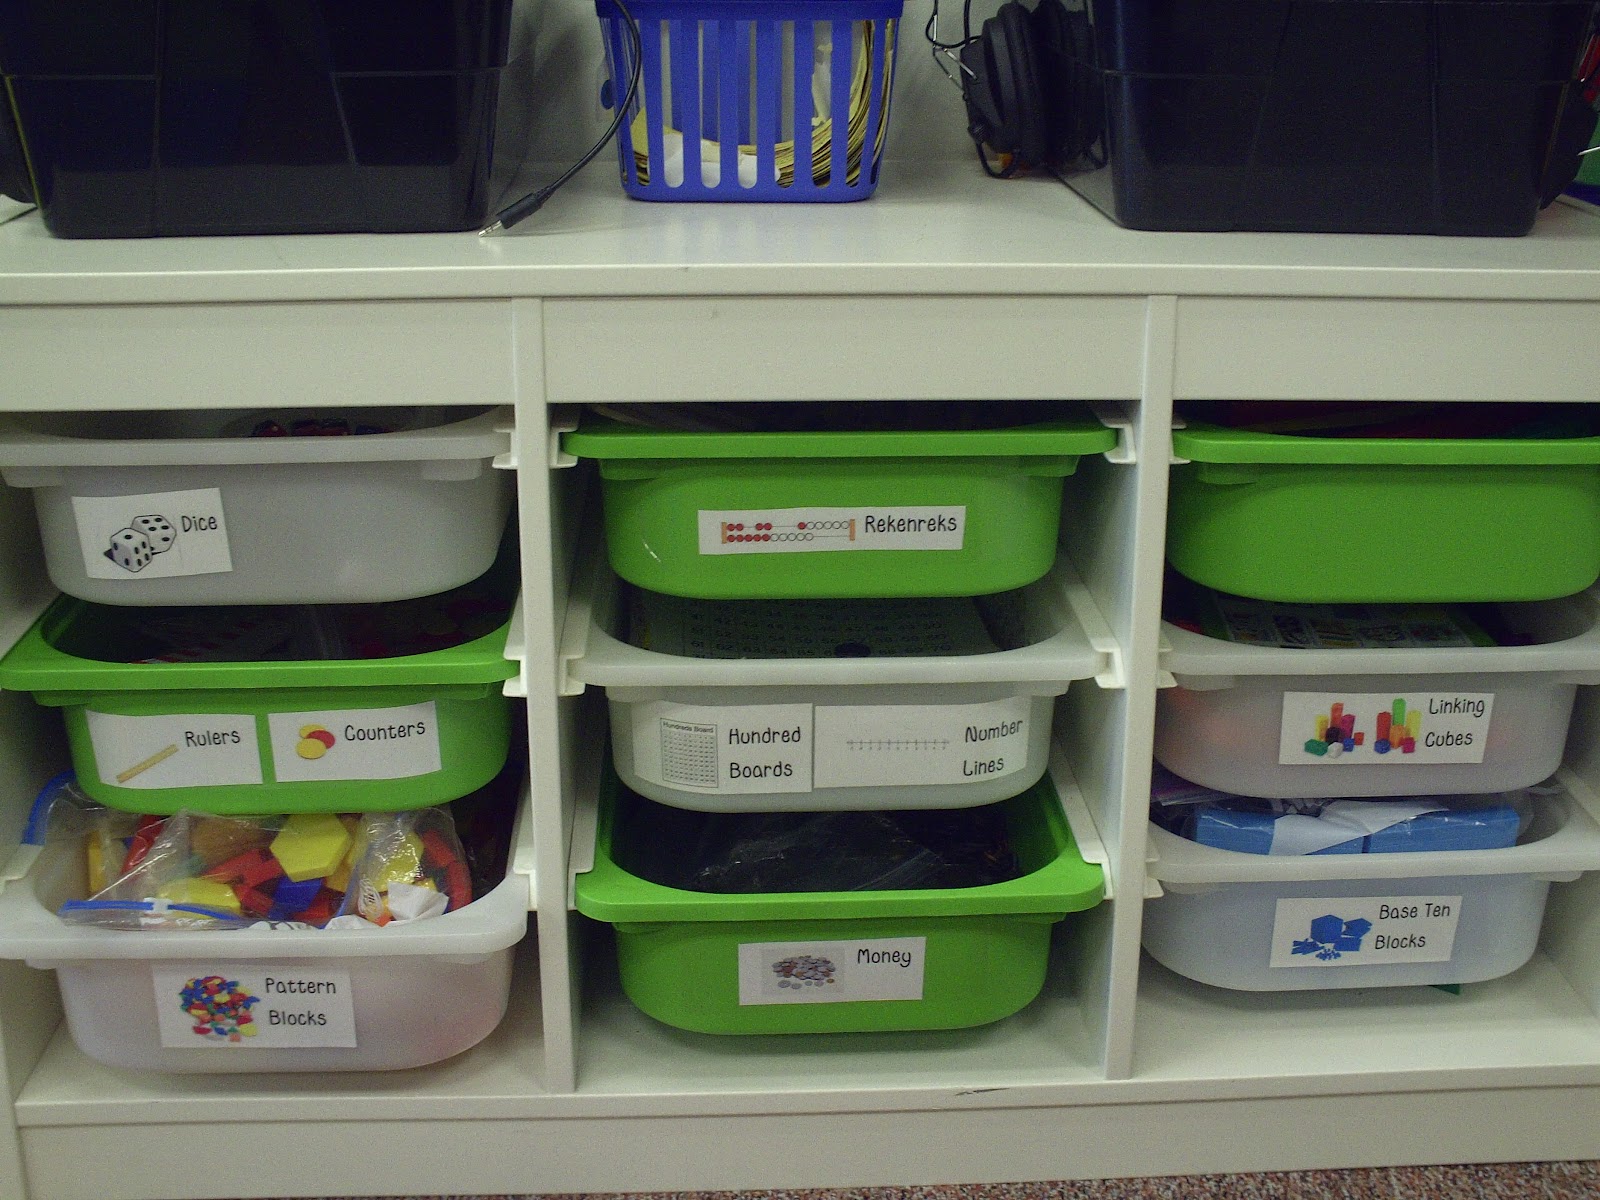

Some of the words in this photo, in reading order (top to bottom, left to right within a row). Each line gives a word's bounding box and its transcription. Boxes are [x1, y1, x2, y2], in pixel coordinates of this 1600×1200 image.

[181, 515, 218, 533] Dice
[864, 514, 958, 533] Rekenreks
[1429, 697, 1485, 718] Linking
[184, 729, 241, 748] Rulers
[344, 721, 426, 741] Counters
[728, 726, 801, 745] Hundred
[965, 719, 1023, 743] Number
[1425, 730, 1473, 748] Cubes
[729, 760, 793, 779] Boards
[963, 757, 1005, 777] Lines
[1379, 904, 1418, 920] Base
[1425, 903, 1451, 918] Ten
[1374, 933, 1426, 950] Blocks
[857, 948, 911, 968] Money
[265, 977, 337, 994] Pattern
[268, 1009, 327, 1026] Blocks
